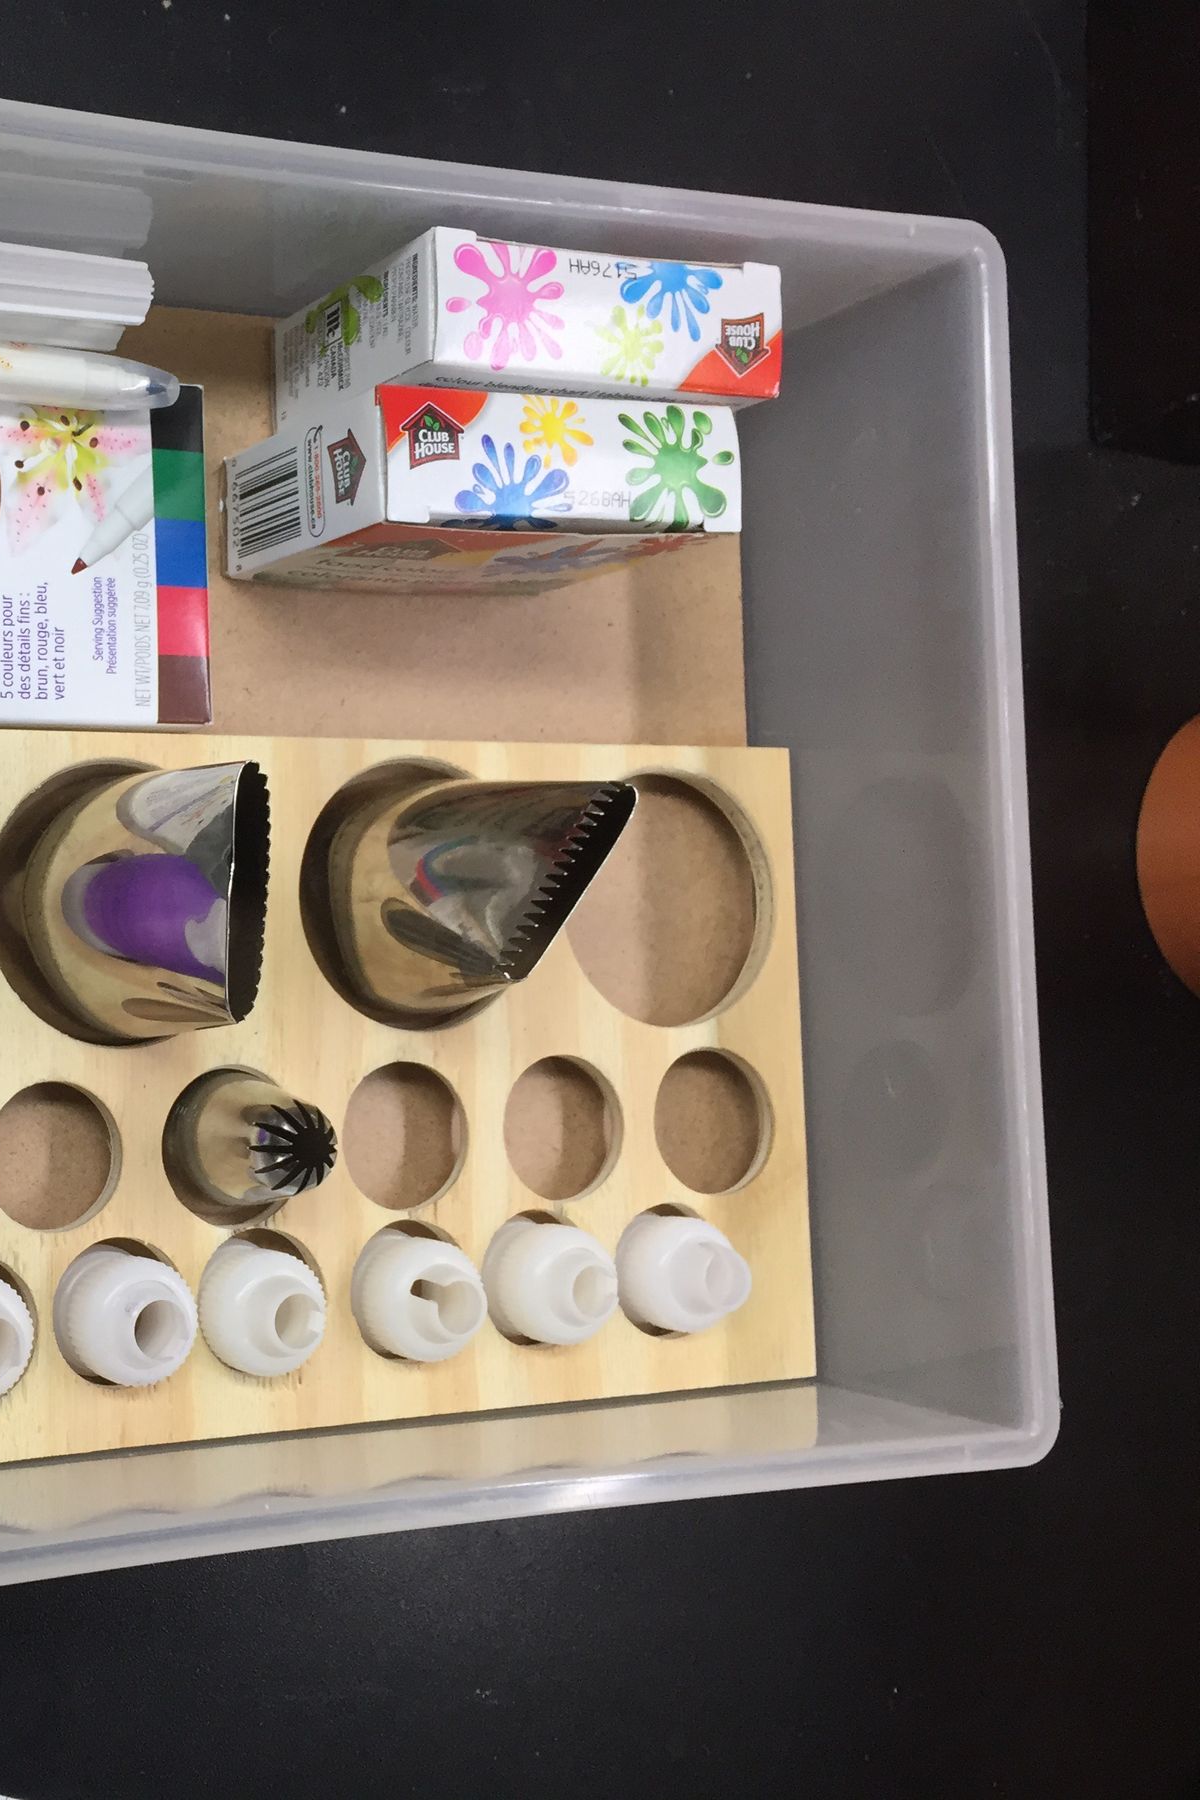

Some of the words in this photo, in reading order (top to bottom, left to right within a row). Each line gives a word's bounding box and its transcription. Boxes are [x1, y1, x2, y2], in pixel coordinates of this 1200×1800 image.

[725, 321, 760, 338] HOUSE
[729, 336, 756, 350] CLUB
[435, 375, 481, 386] colour
[483, 380, 549, 394] blending
[418, 428, 450, 443] CLUB
[414, 442, 456, 459] HOUSE
[333, 448, 345, 496] HOUSE
[342, 450, 351, 489] CLUB
[34, 582, 49, 615] bleu,
[105, 577, 118, 618] suggérée
[136, 580, 152, 589] g
[2, 594, 15, 627] pour
[17, 599, 30, 624] fins
[91, 576, 104, 626] Suggestion
[134, 613, 150, 632] NET
[17, 627, 31, 672] détails
[37, 618, 50, 662] rouge,
[52, 626, 65, 653] noir
[92, 627, 104, 661] Serving
[105, 619, 117, 675] Présentation
[0, 630, 14, 688] couleurs
[52, 657, 65, 670] et
[134, 634, 152, 686] WT/POIDS
[0, 690, 14, 699] 5
[17, 675, 31, 700] des
[35, 665, 49, 700] brun,
[53, 673, 65, 701] vert
[134, 687, 151, 707] NET
